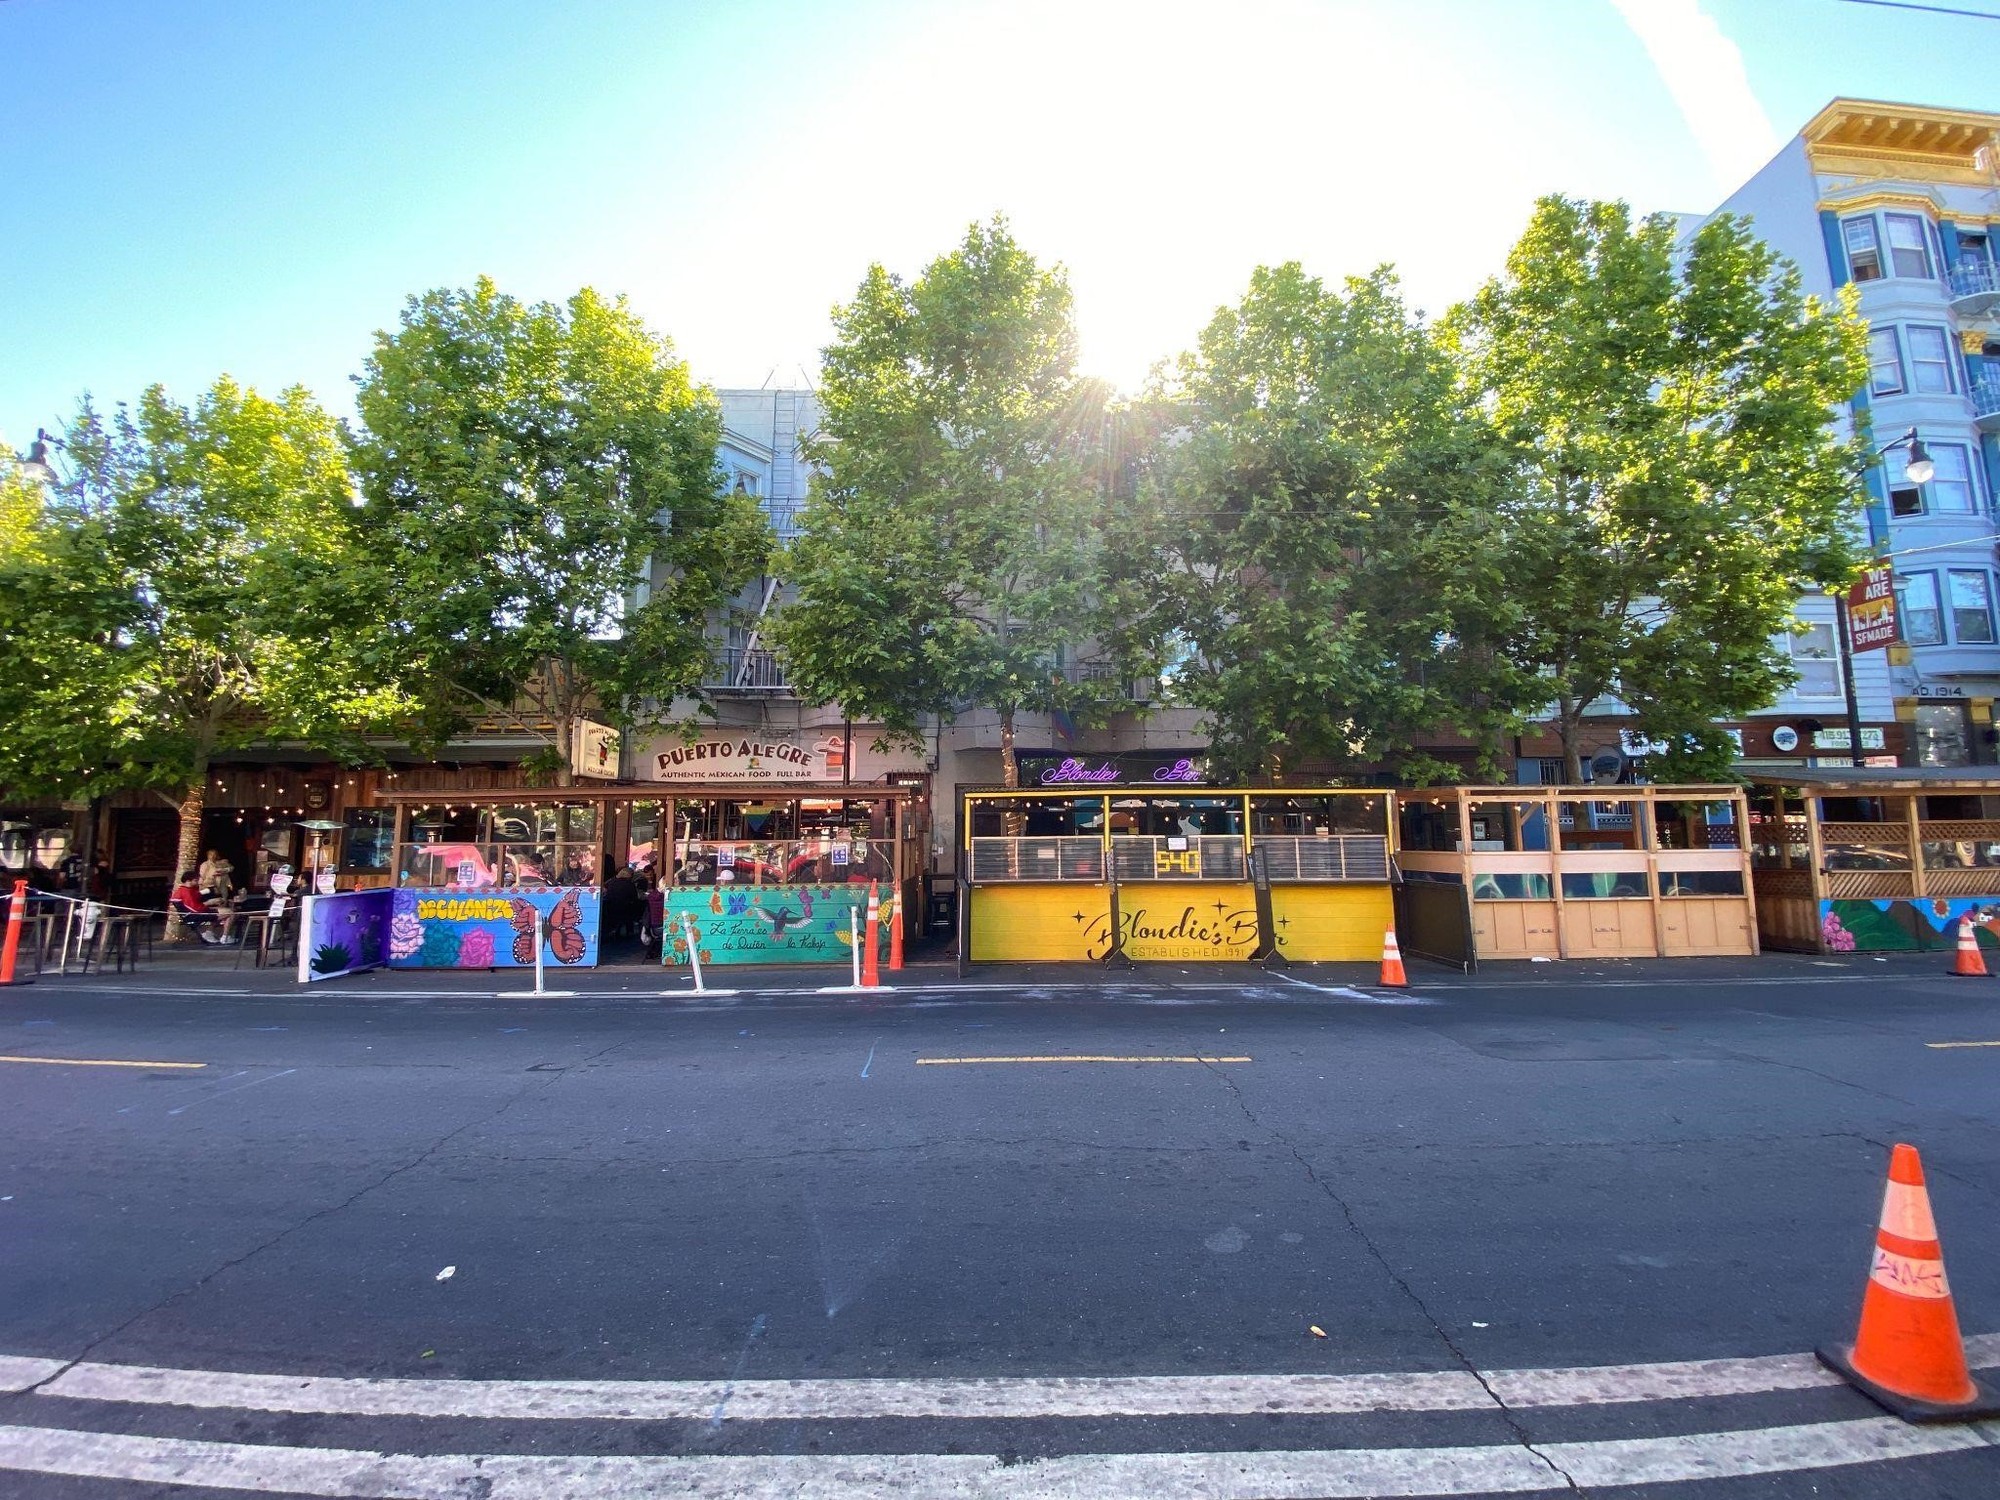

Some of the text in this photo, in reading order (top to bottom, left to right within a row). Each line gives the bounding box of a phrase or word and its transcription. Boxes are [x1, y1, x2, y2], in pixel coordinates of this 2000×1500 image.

[1868, 569, 1888, 583] WE
[1865, 584, 1890, 600] ARE
[1855, 626, 1894, 645] SFMADE
[657, 739, 813, 770] PUERTO ALEGRE
[660, 771, 706, 779] AUTHENTIC
[1153, 759, 1199, 781] Bar
[1156, 851, 1200, 873] 540
[710, 921, 727, 936] La
[722, 937, 734, 949] de
[1130, 947, 1245, 957] ESTABLISHED 1991
